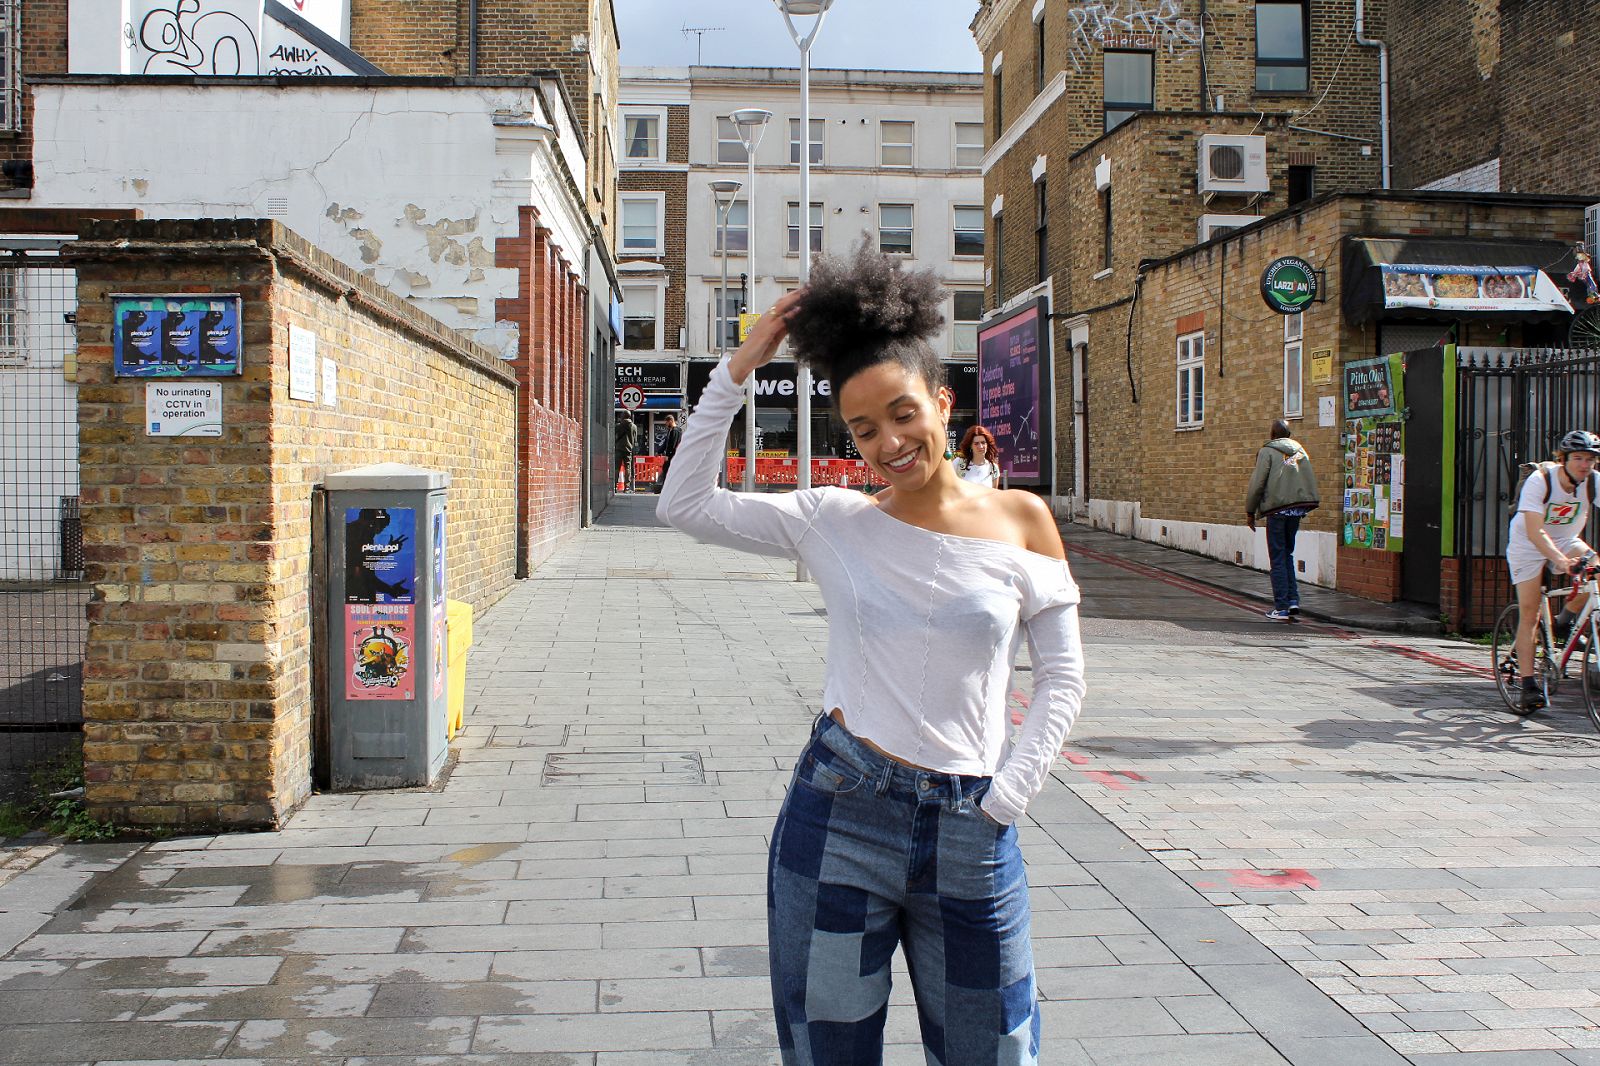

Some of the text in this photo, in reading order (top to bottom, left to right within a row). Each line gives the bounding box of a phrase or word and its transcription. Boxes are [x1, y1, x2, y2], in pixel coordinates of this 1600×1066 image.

[1282, 259, 1303, 268] VEGAN
[1303, 265, 1316, 290] CUISINE
[615, 366, 642, 376] ECH
[156, 388, 211, 398] No urinating
[623, 392, 641, 403] 20
[165, 400, 202, 408] CCTV in
[162, 410, 206, 419] operation
[361, 543, 399, 553] plentyppl
[350, 605, 409, 614] SOUL PURPOSE
